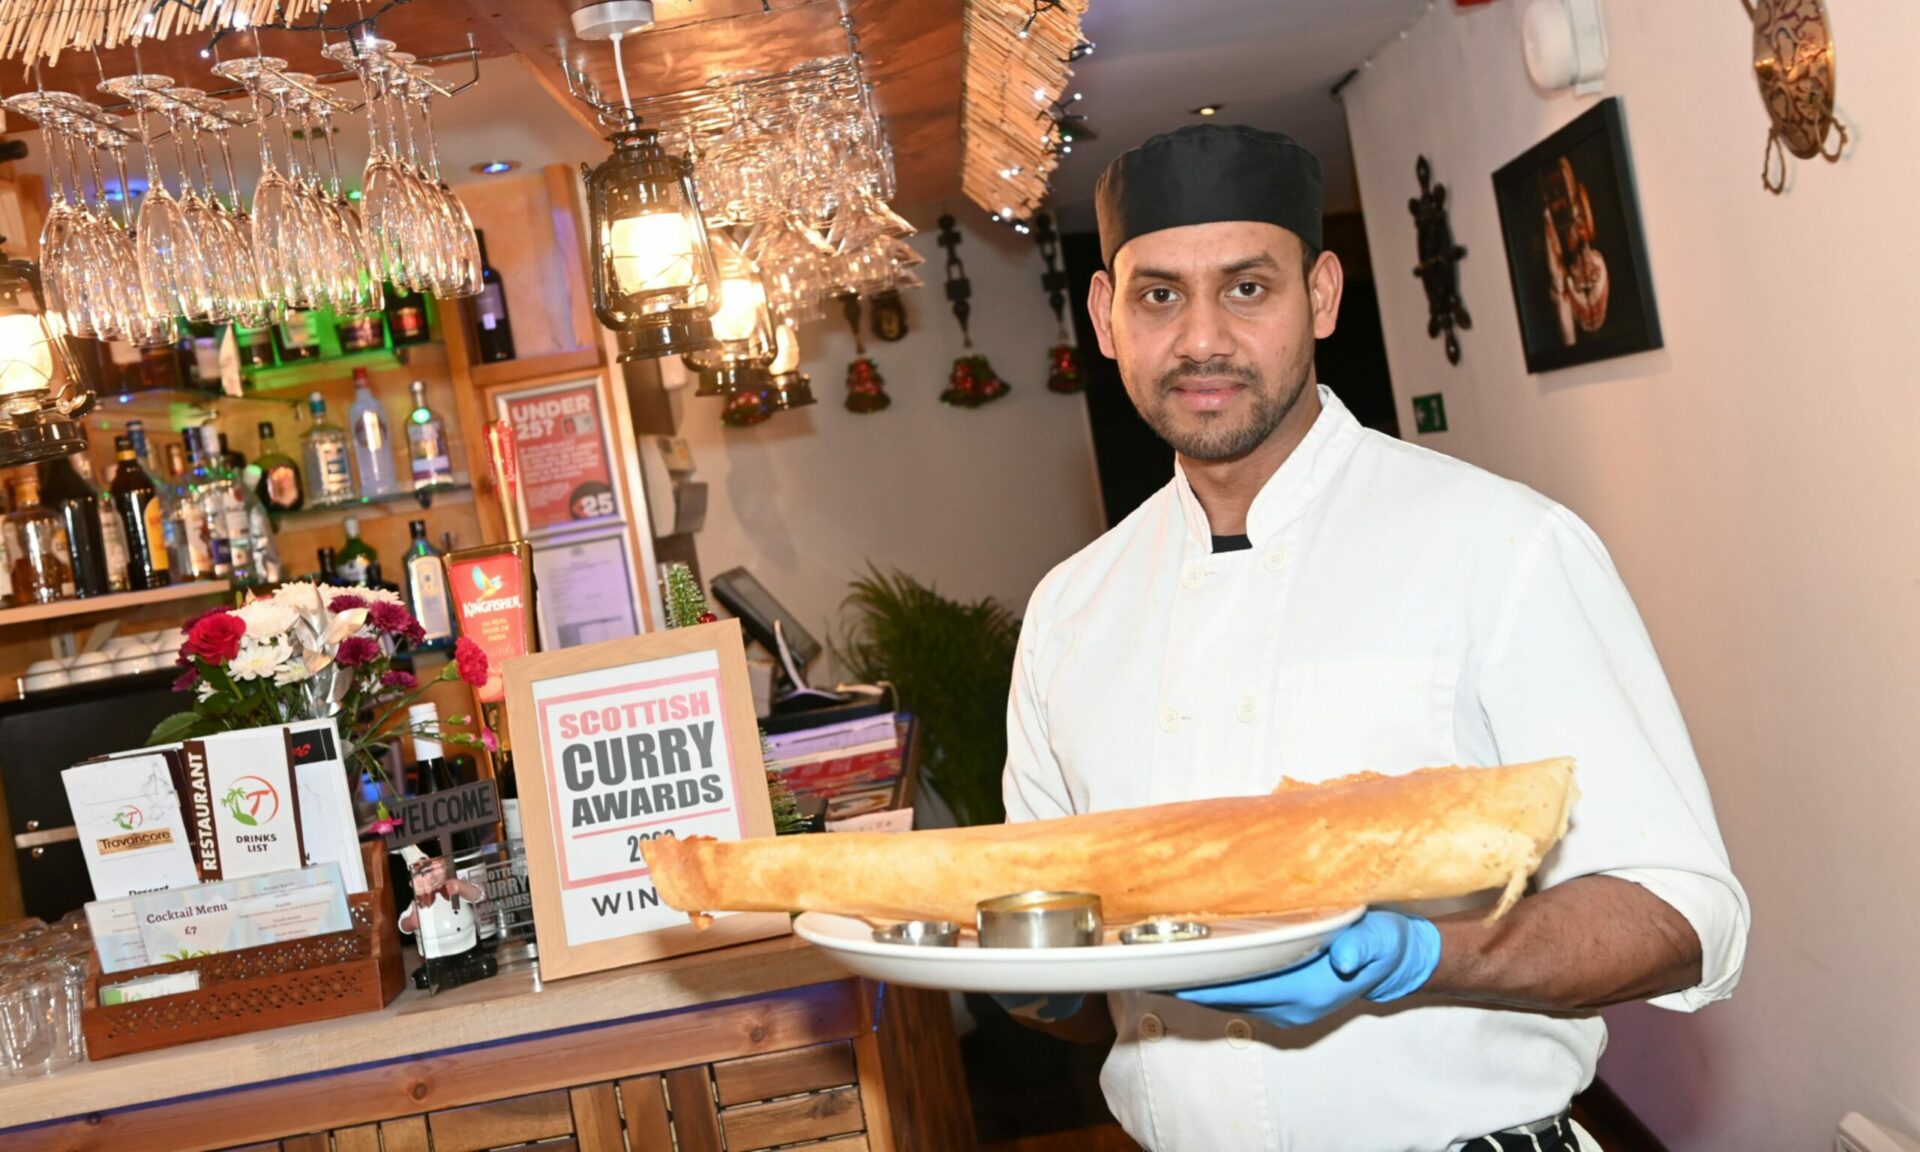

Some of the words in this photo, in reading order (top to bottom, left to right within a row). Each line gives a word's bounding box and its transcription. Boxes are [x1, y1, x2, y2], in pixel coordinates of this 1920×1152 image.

[511, 394, 591, 422] UNDER
[516, 419, 555, 441] 25?
[582, 492, 614, 517] 25
[463, 595, 522, 618] KINGFISHER
[559, 691, 711, 740] SCOTTISH
[562, 720, 715, 792] CURRY
[188, 752, 218, 871] RESTAURANT
[390, 786, 493, 839] WELCOME
[571, 774, 724, 828] AWARDS
[100, 830, 172, 851] Travancore
[236, 834, 277, 844] DRINKS
[247, 844, 268, 853] LIST
[485, 875, 529, 902] URRY
[591, 885, 659, 918] WIN
[146, 906, 194, 925] Cocktail
[195, 901, 229, 918] Menu
[184, 925, 198, 936] £7
